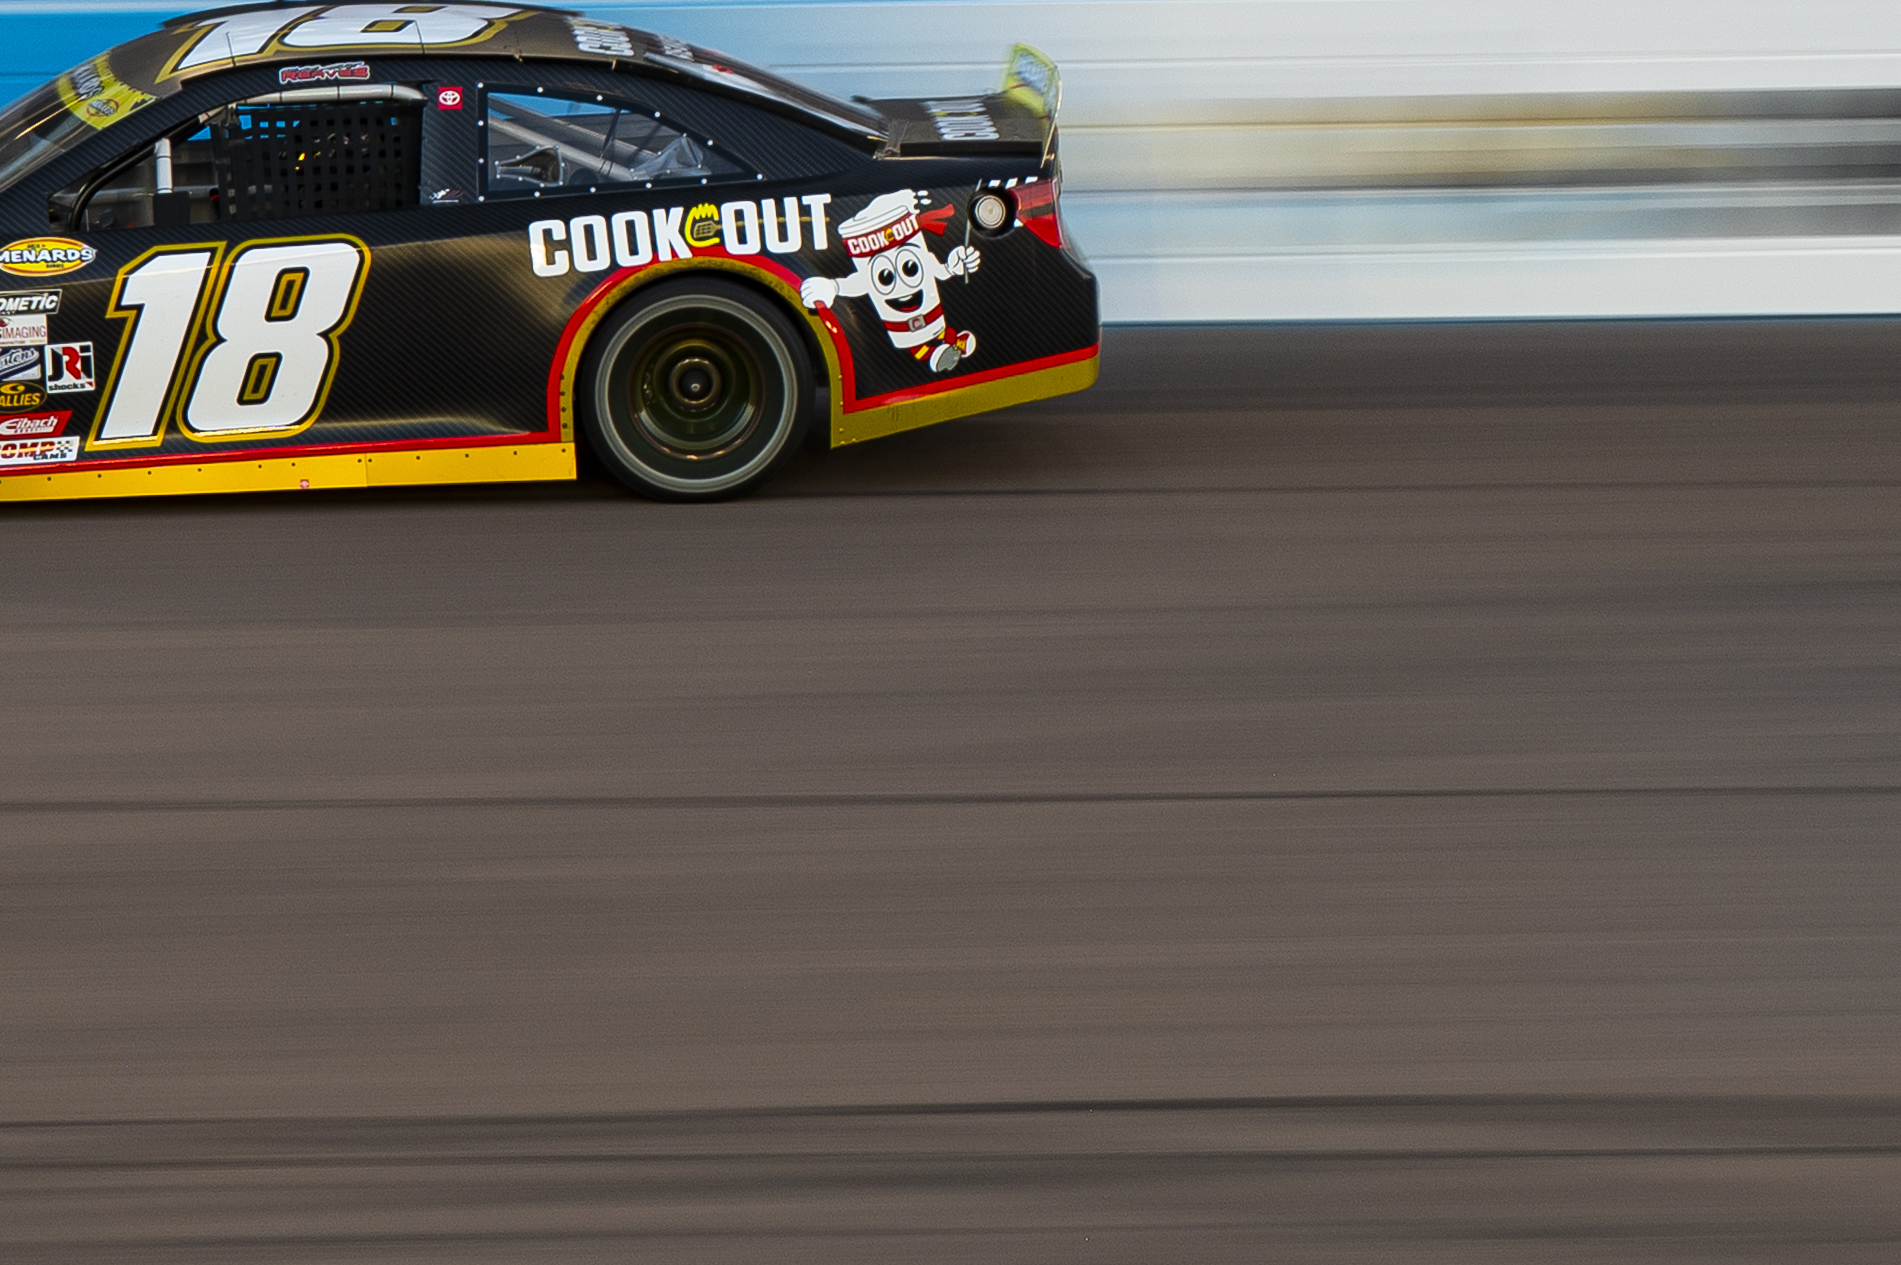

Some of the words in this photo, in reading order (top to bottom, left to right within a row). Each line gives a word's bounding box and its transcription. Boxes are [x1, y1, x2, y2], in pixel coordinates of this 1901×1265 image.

[156, 4, 538, 82] 18
[280, 66, 369, 82] REAVES
[529, 207, 693, 277] COOK
[720, 193, 832, 255] OUT
[847, 232, 889, 255] COOK
[892, 215, 920, 241] OUT
[88, 234, 370, 449] 18
[48, 382, 86, 391] shocks
[33, 452, 68, 461] CAMS
